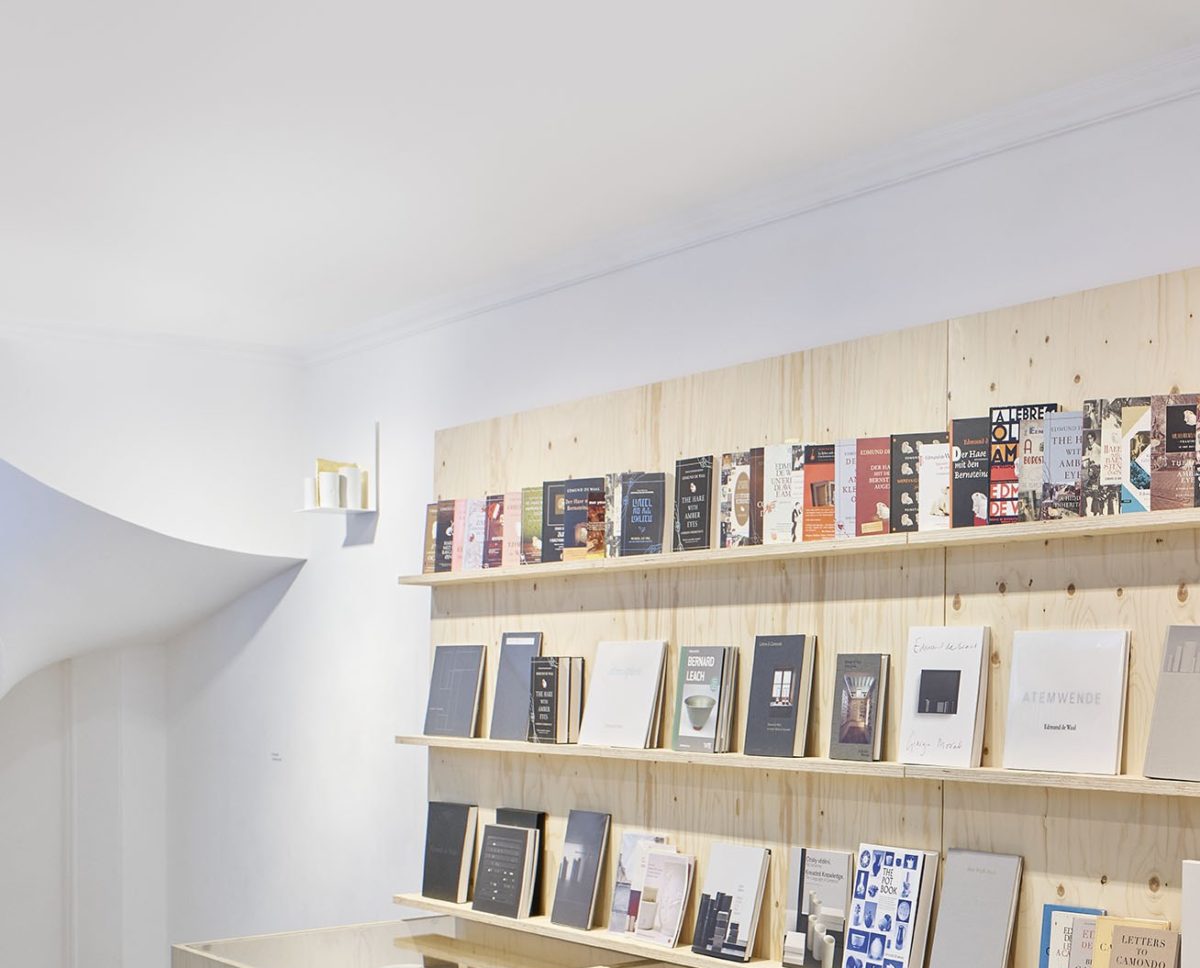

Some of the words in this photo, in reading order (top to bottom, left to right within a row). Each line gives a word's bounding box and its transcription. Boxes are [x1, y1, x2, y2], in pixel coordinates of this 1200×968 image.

[1009, 407, 1046, 421] LEBRE
[1024, 438, 1032, 455] A
[1053, 436, 1073, 446] THE
[860, 448, 883, 456] EDMUND
[952, 446, 968, 462] Der
[969, 449, 987, 458] Hase
[954, 461, 966, 469] mit
[967, 460, 979, 469] den
[990, 501, 1007, 517] DE
[687, 656, 715, 668] BERNARD
[687, 671, 705, 682] LEACH
[1022, 691, 1102, 705] ATEMWENDE
[883, 867, 894, 877] THE
[882, 876, 894, 887] POT
[880, 886, 898, 896] BOOK
[1082, 941, 1093, 950] DE
[1121, 934, 1166, 948] LETTERS
[1136, 947, 1148, 956] TO
